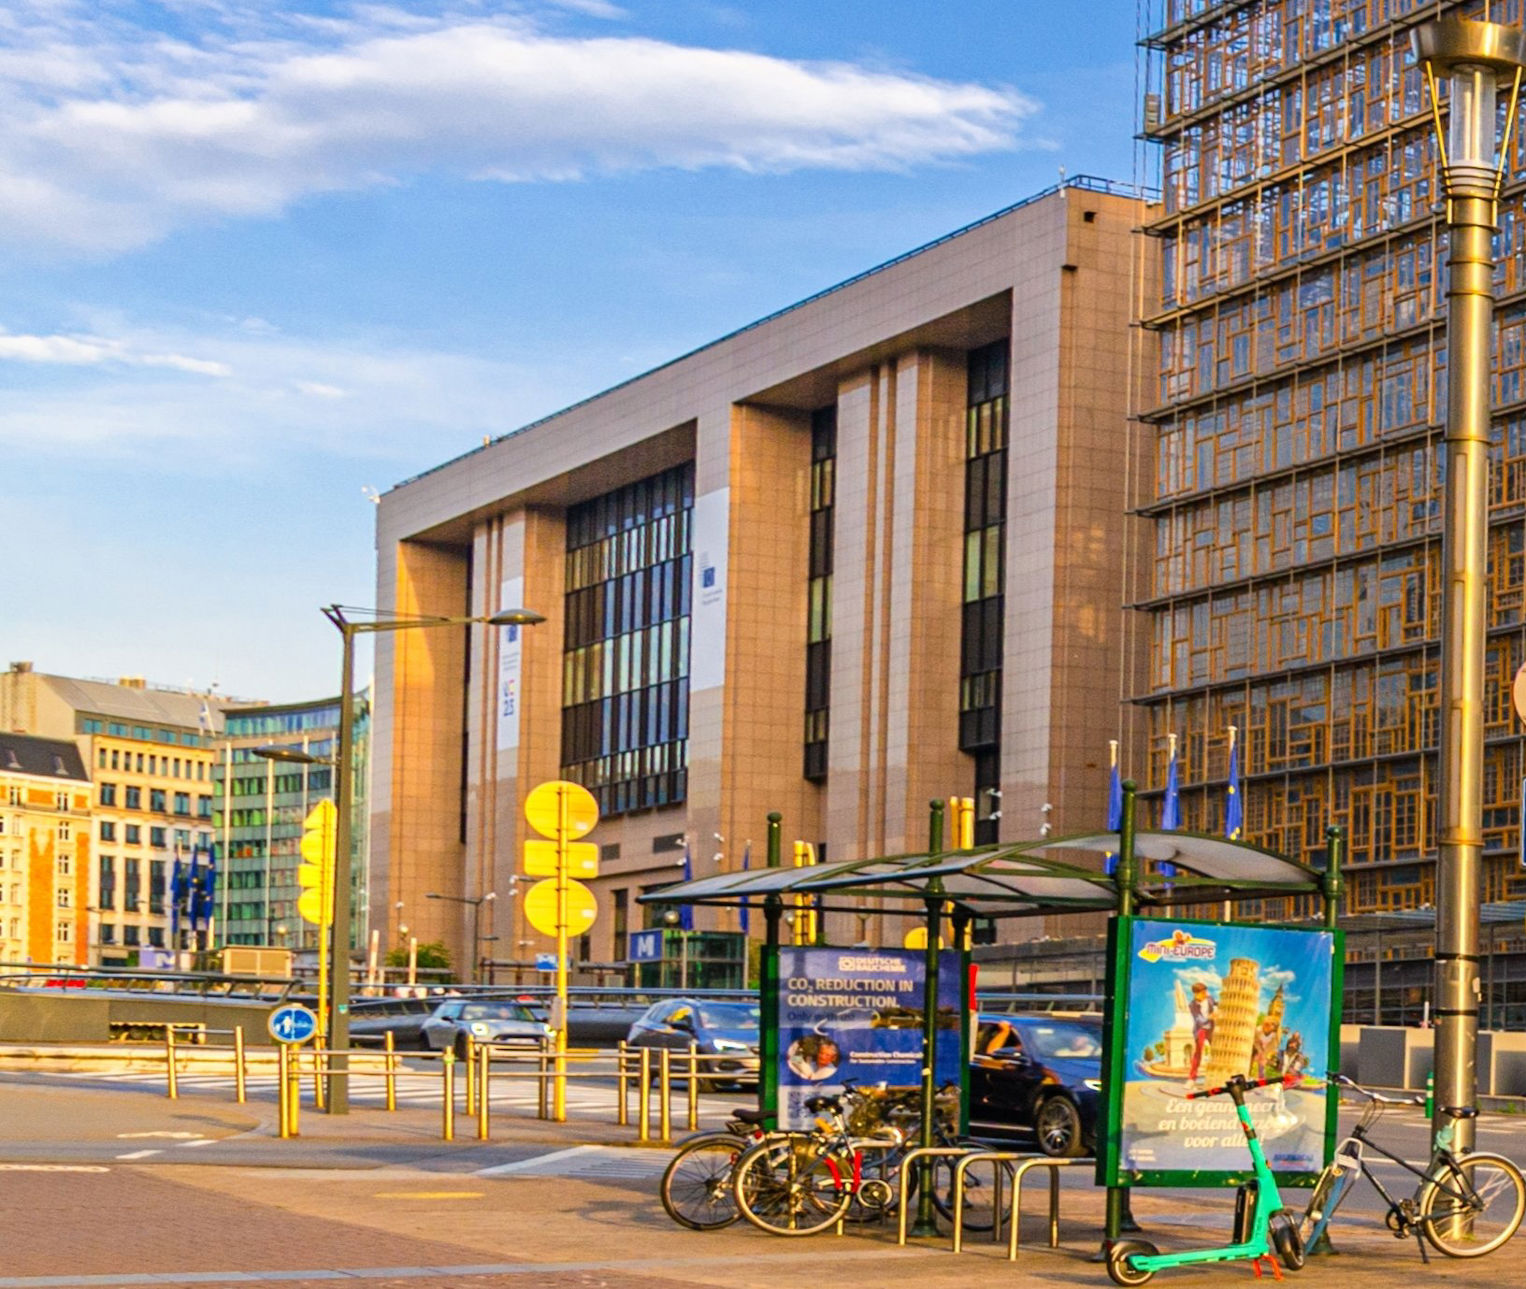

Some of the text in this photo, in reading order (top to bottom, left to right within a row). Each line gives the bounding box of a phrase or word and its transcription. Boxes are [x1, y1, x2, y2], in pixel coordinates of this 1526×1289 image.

[637, 935, 655, 957] M
[816, 978, 896, 991] REDUCTION
[899, 980, 913, 992] IN
[787, 995, 900, 1008] CONSTRUCTION.
[1166, 1098, 1193, 1113] Een
[1158, 1119, 1176, 1130] en
[1184, 1136, 1219, 1148] voor
